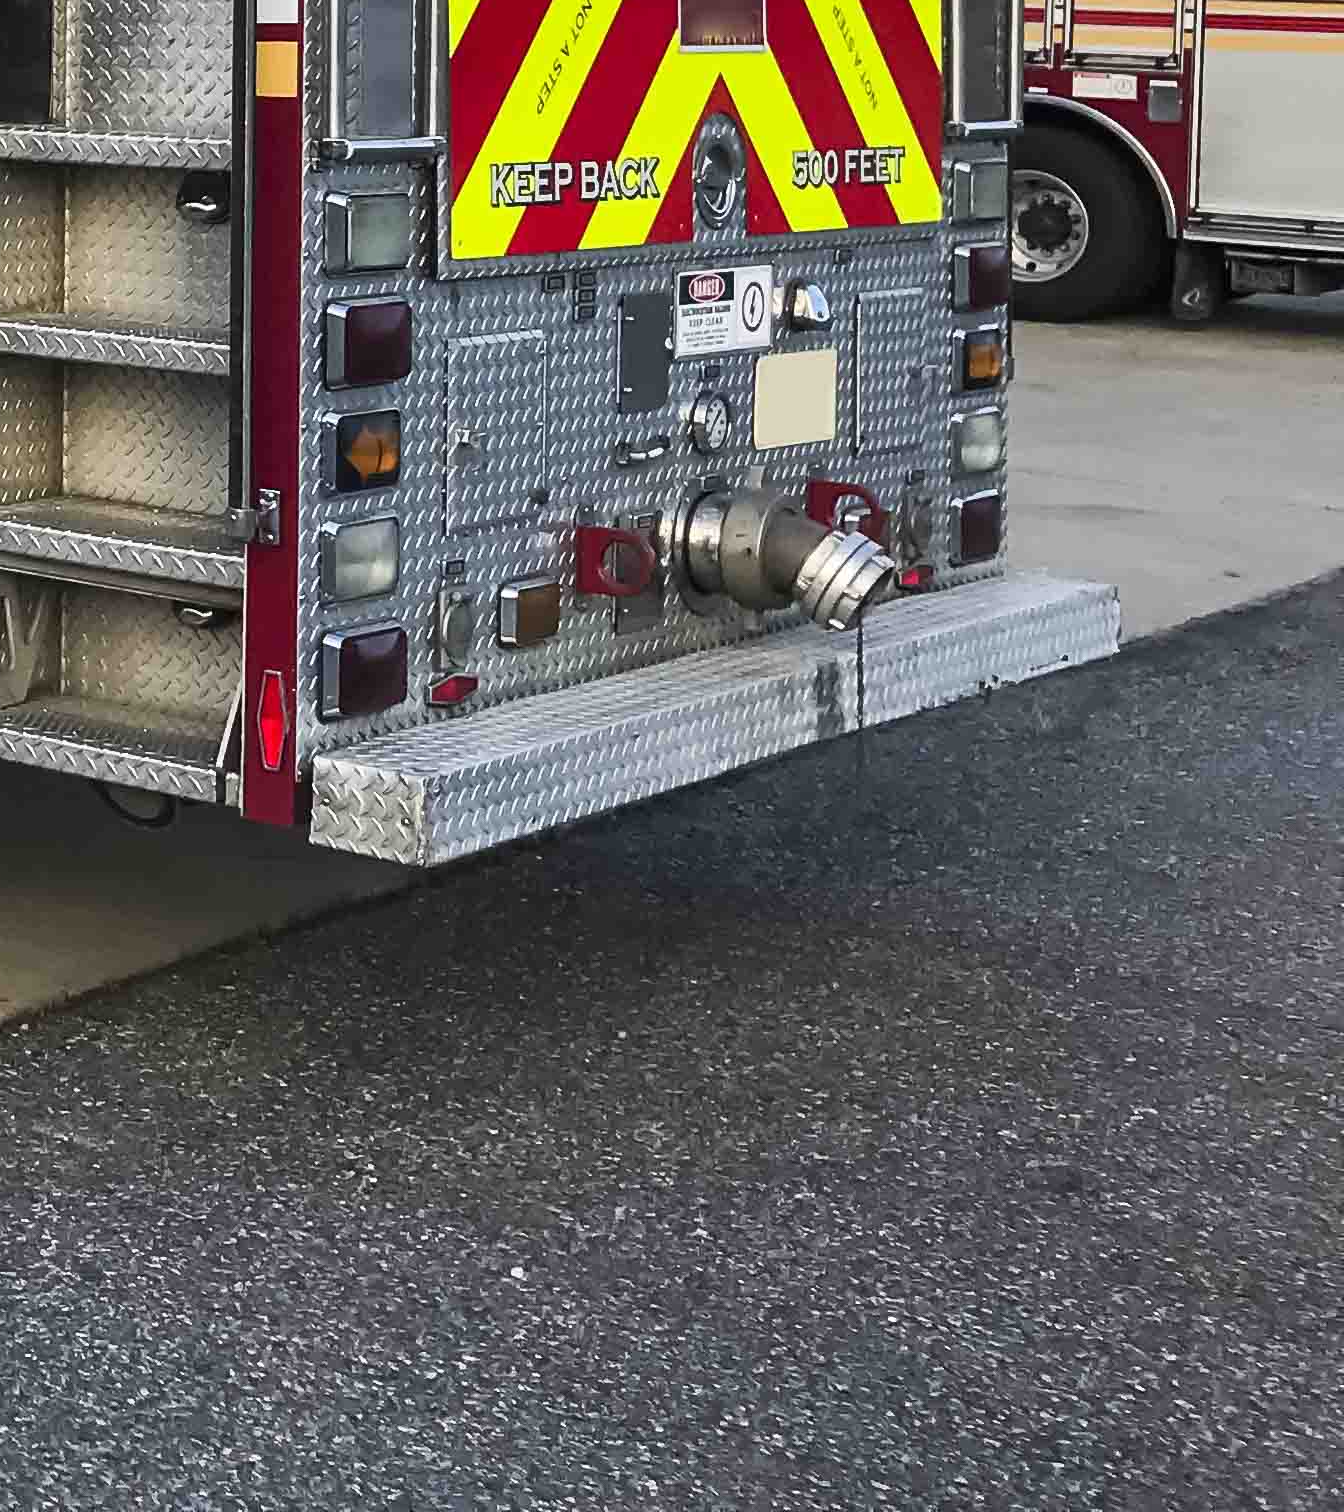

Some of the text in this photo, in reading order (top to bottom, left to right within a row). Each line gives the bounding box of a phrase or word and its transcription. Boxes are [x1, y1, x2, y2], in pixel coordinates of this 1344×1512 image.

[537, 58, 562, 115] STEP
[859, 71, 877, 110] NOT
[490, 157, 660, 207] KEEP BACK
[792, 146, 905, 189] 500 FEET
